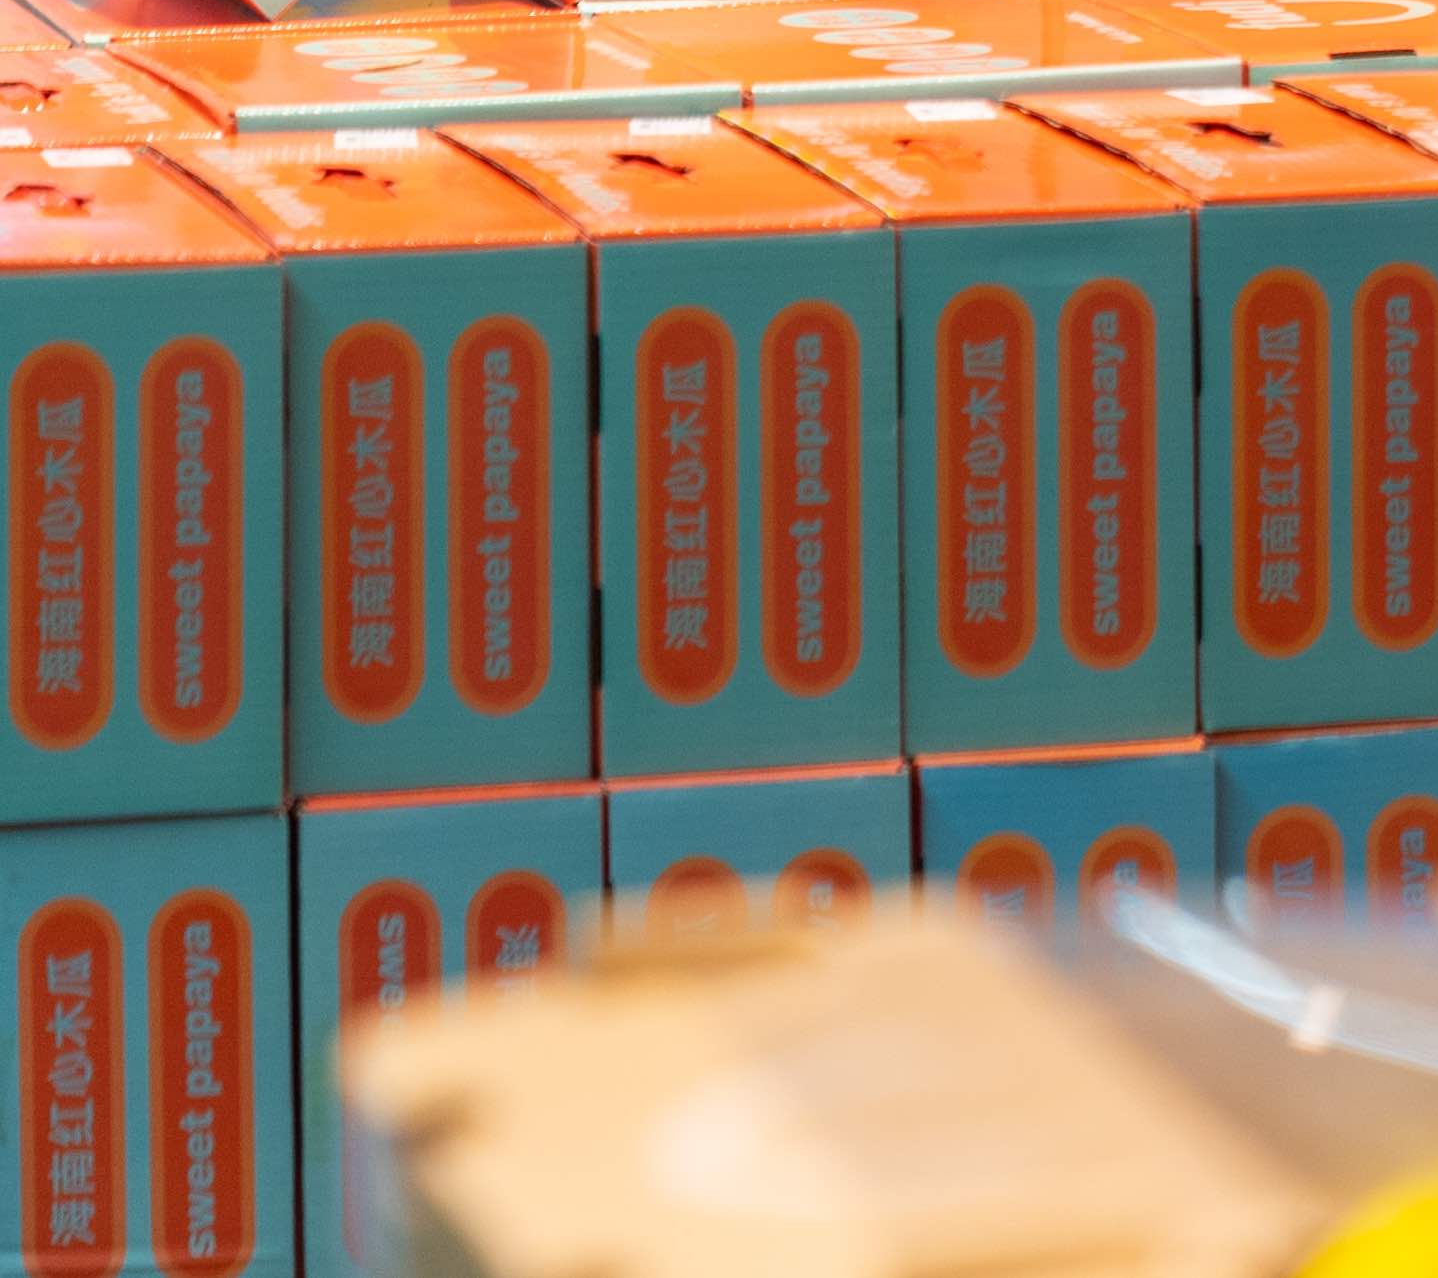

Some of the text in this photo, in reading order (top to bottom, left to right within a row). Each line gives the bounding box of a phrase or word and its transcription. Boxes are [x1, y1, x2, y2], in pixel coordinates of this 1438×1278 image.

[36, 394, 85, 693] 海南红心木瓜
[168, 369, 215, 707] sweet papaya
[349, 374, 395, 669] 海南红心木瓜
[475, 349, 519, 681] sweet papaya
[663, 359, 710, 649] 海南红心木瓜
[791, 332, 832, 663] sweet papaya
[963, 336, 1008, 623] 海南红心木瓜
[1086, 309, 1127, 637] sweet papaya
[1256, 318, 1301, 604] 海南红心木瓜
[1378, 294, 1420, 618] sweet papaya
[47, 949, 97, 1247] 海南红心木瓜
[178, 922, 223, 1259] sweet papaya
